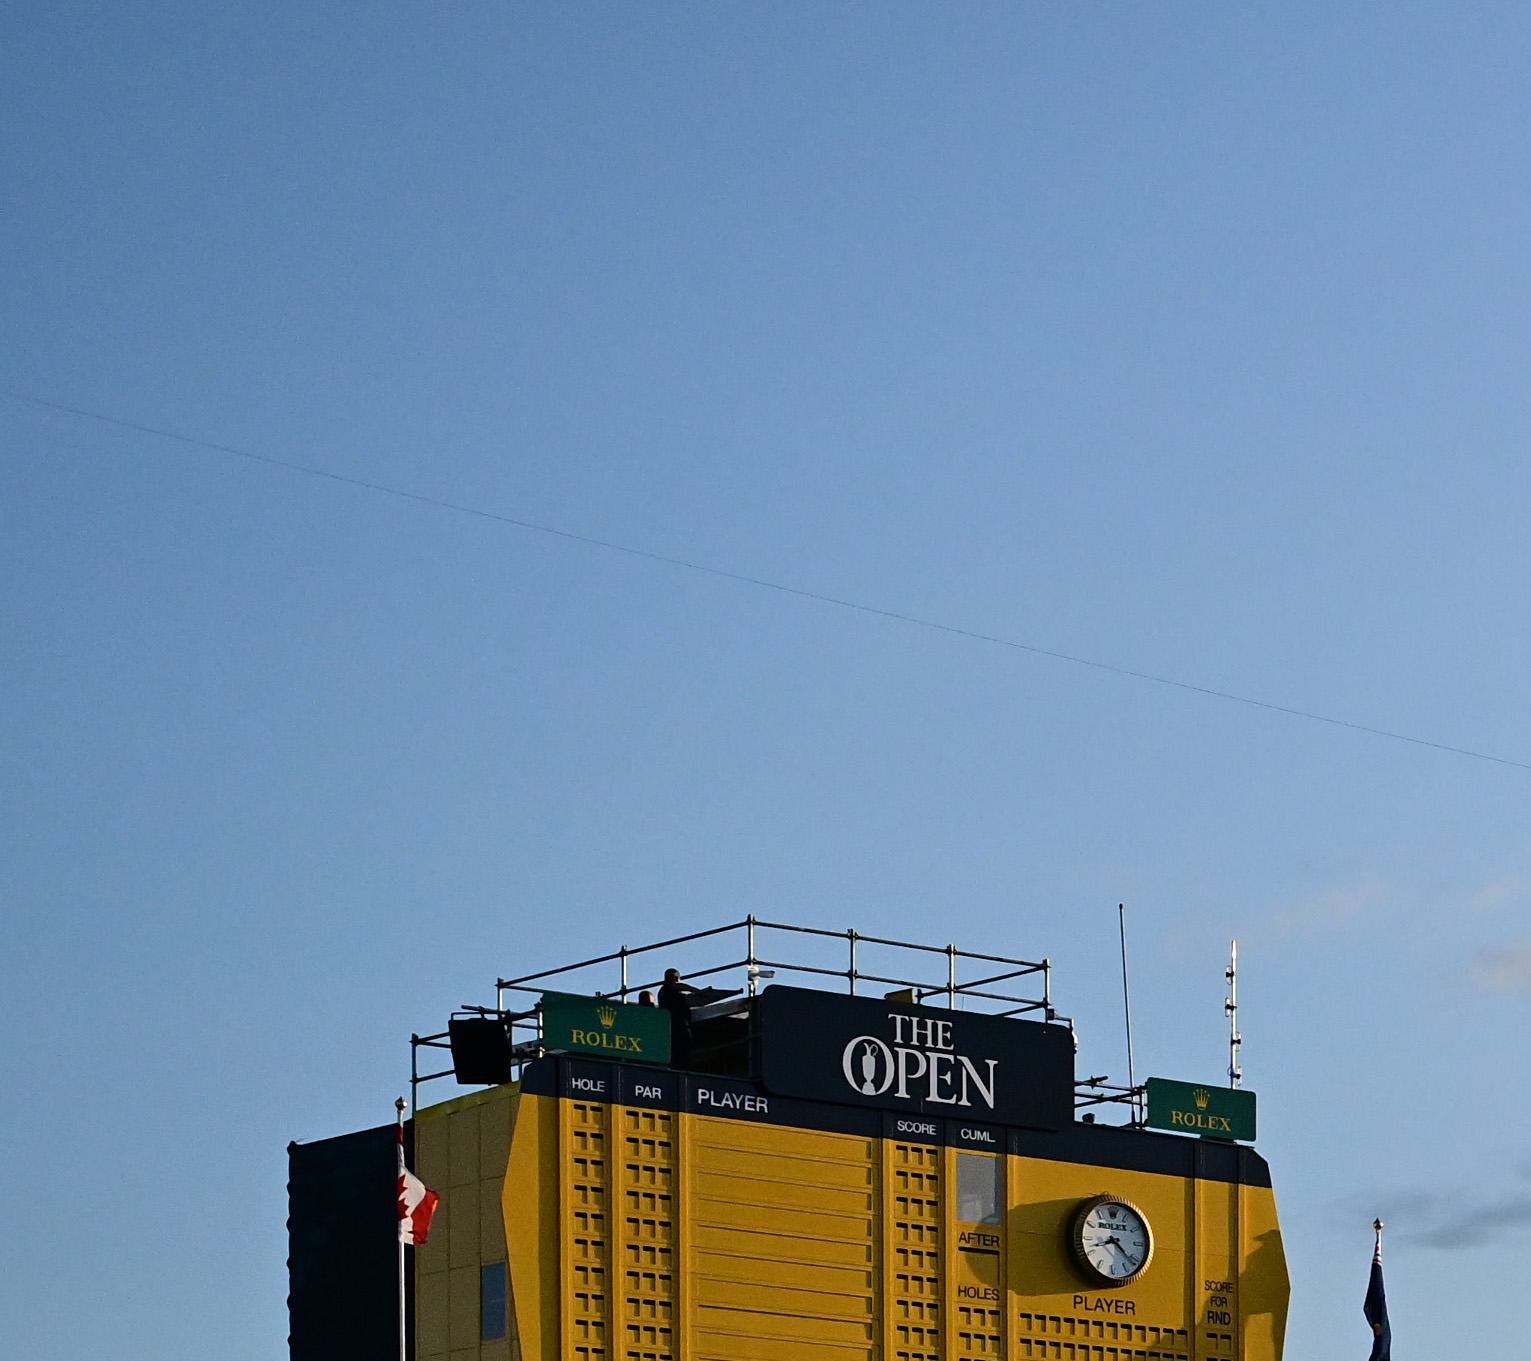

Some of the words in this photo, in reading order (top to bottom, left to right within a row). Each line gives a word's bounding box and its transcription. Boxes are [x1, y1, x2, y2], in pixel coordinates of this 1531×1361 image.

[888, 1013, 955, 1050] THE
[571, 1029, 643, 1052] ROLEX
[842, 1035, 998, 1109] OPEN
[571, 1077, 605, 1092] HOLE
[635, 1085, 662, 1100] PAR
[697, 1088, 769, 1113] PLAYER
[897, 1120, 937, 1136] SCORE
[1170, 1110, 1232, 1132] ROLEX
[960, 1128, 996, 1143] CUML
[1098, 1222, 1127, 1232] ROLEX
[958, 1231, 999, 1247] AFTER
[957, 1285, 999, 1301] HOLES
[1204, 1280, 1233, 1293] SCORE
[1073, 1295, 1136, 1316] PLAYER
[1210, 1296, 1228, 1307] FOR
[1207, 1311, 1232, 1326] RND
